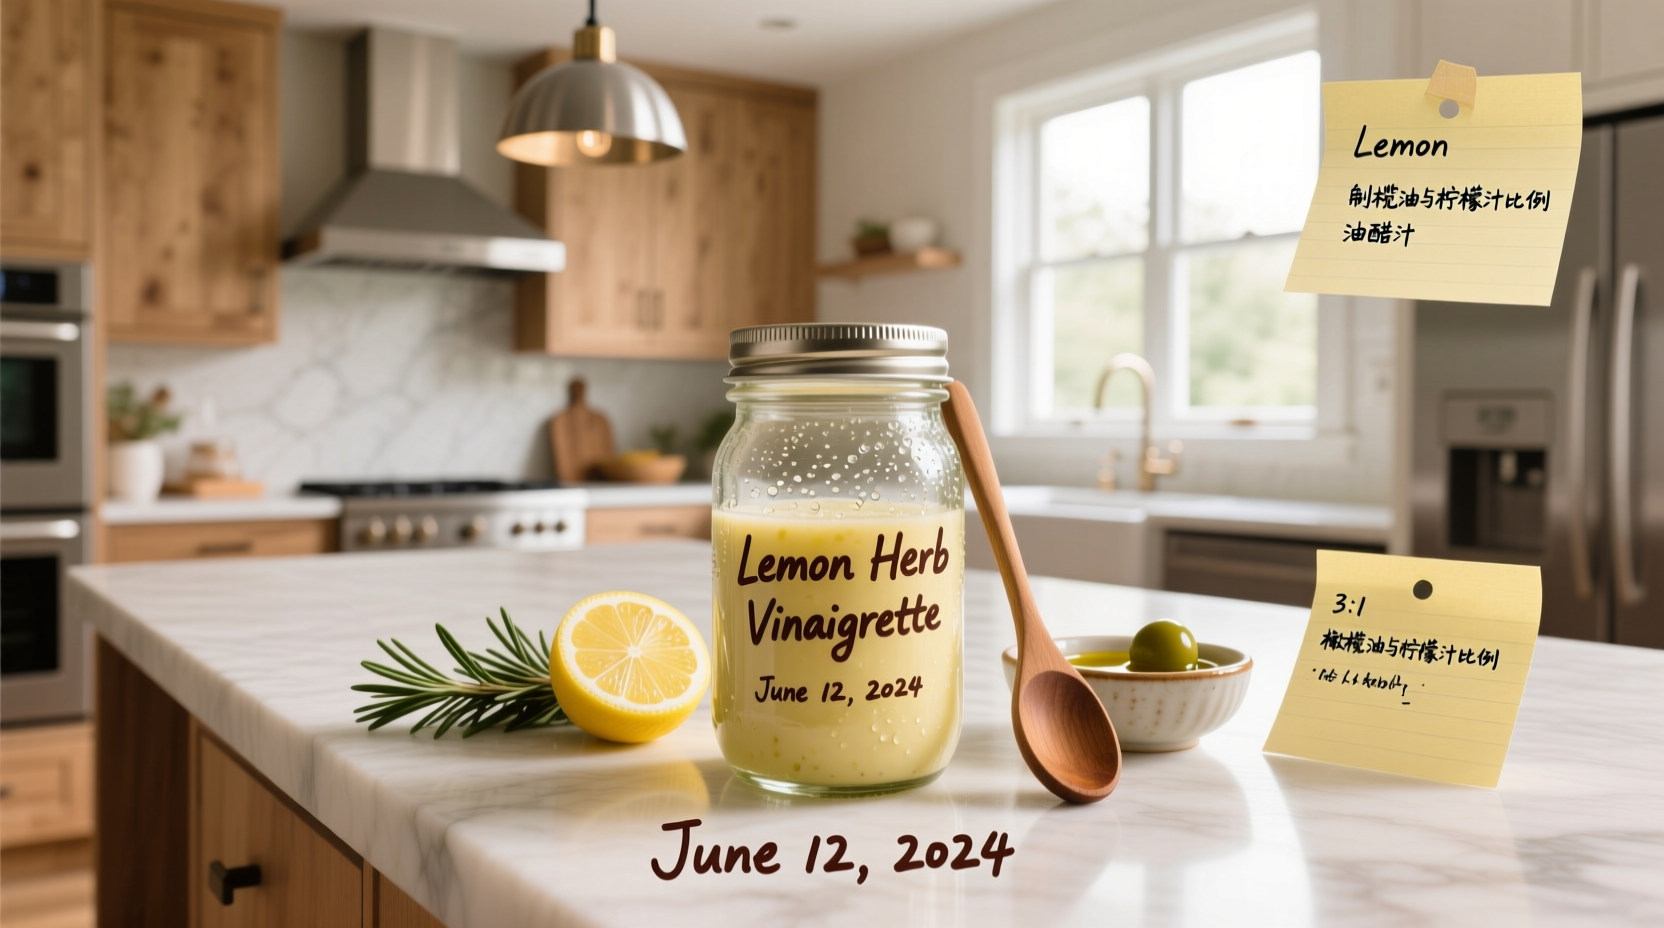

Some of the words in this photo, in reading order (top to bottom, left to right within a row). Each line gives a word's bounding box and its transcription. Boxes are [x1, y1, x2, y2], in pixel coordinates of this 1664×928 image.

[1353, 124, 1448, 159] Lemon
[1342, 220, 1416, 248] 油醋汁
[736, 533, 855, 587] Lemon
[869, 526, 949, 582] Herb
[1332, 593, 1366, 617] 3:1
[747, 593, 941, 663] Vinaigrette
[754, 674, 809, 704] June
[821, 681, 854, 708] 12,
[865, 675, 924, 702] 2024
